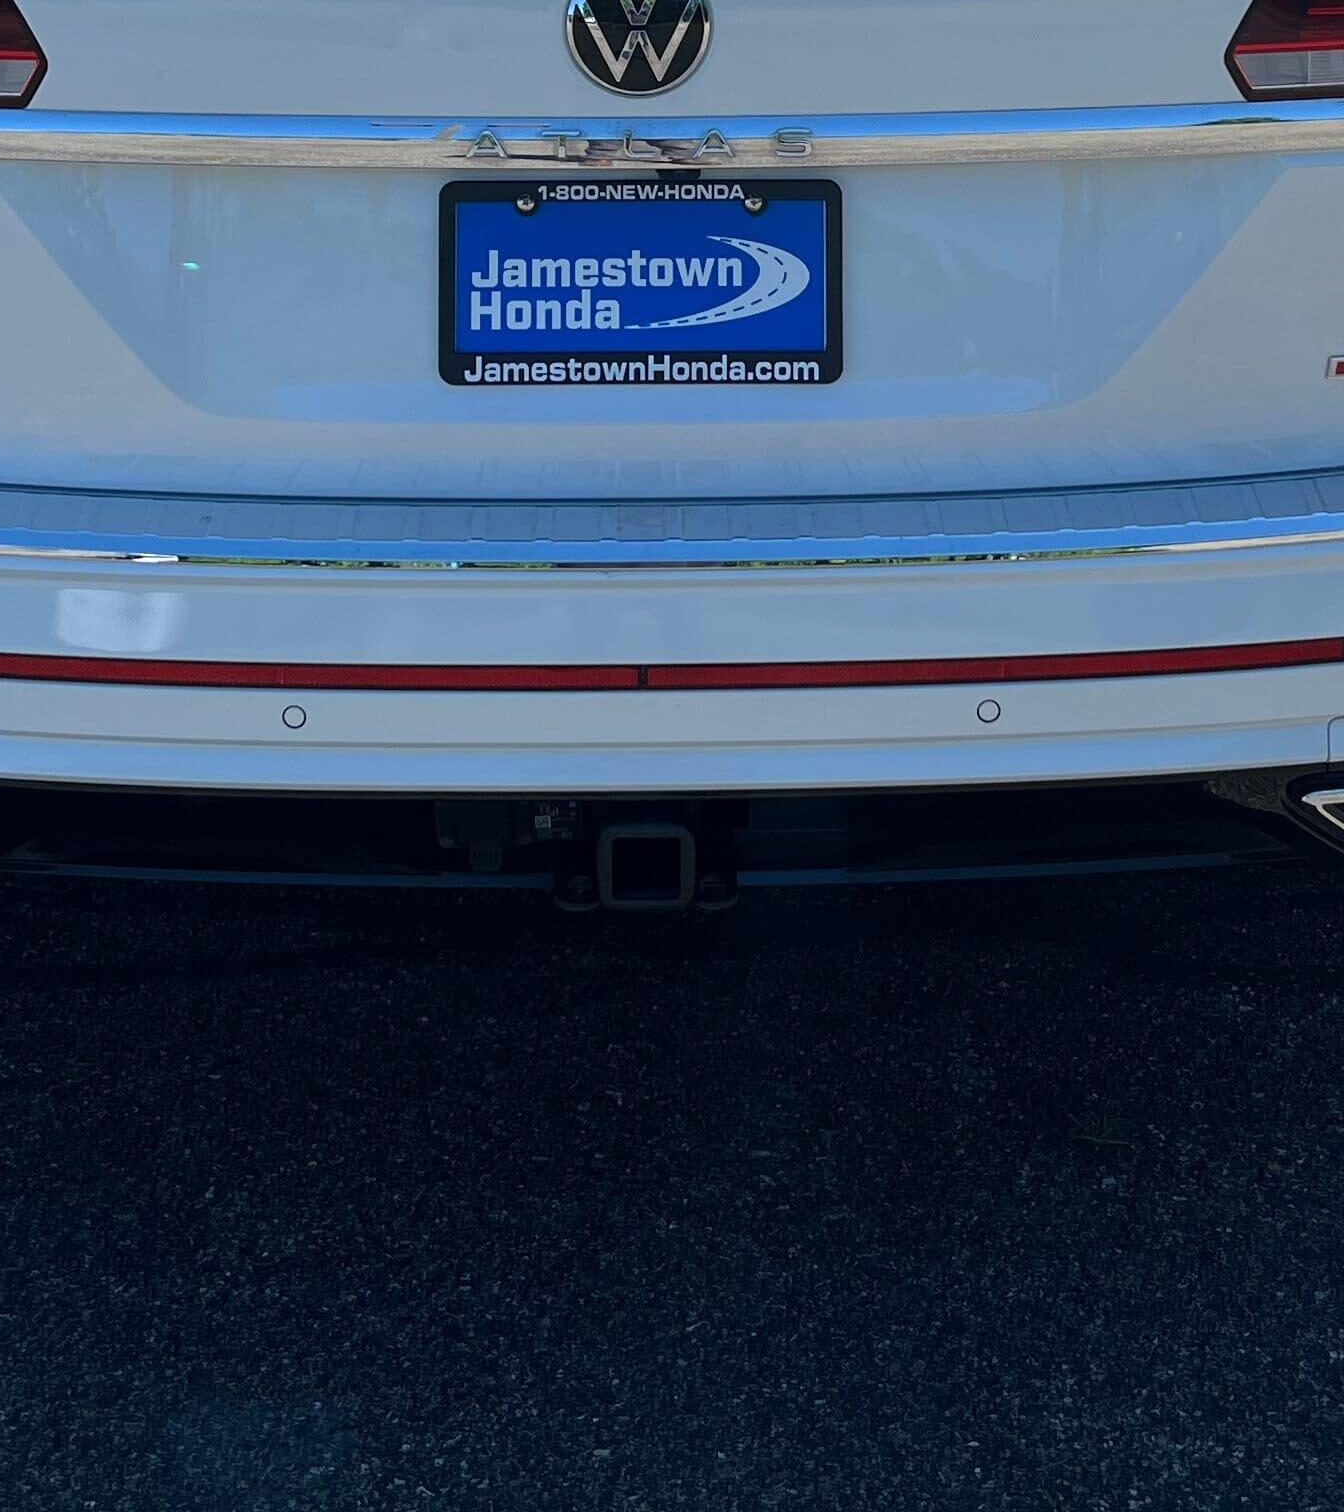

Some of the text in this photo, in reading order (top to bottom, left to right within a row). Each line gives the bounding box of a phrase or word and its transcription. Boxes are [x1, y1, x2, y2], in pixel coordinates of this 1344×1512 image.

[465, 128, 813, 160] ATLAS
[537, 184, 746, 201] 1-800-NEW-HONDA
[470, 249, 743, 288] Jamestown
[470, 290, 622, 330] Honda
[463, 355, 820, 383] JamestownHonda.com
